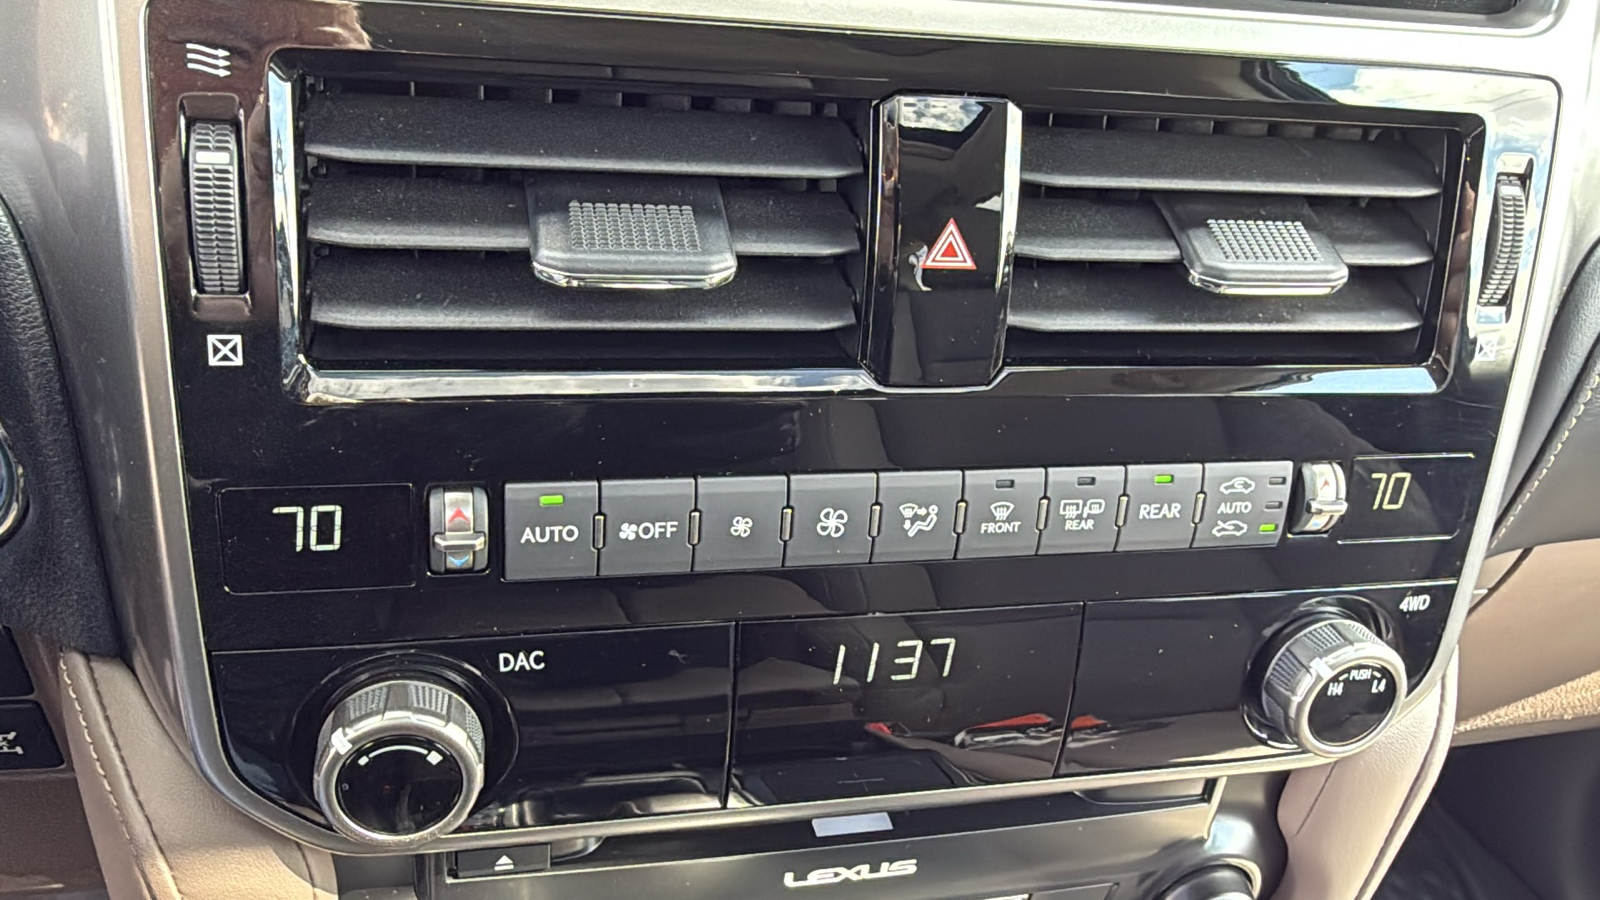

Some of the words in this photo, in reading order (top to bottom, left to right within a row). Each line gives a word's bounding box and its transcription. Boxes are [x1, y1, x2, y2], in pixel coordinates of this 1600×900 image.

[1371, 472, 1411, 511] 70
[1139, 502, 1182, 520] REAR
[1217, 500, 1252, 515] AUTO
[272, 504, 342, 552] 70
[638, 521, 679, 539] OFF
[980, 521, 1021, 536] FRONT
[1064, 518, 1095, 532] REAR
[520, 525, 579, 544] AUTO
[1399, 594, 1431, 612] 4WD
[498, 651, 546, 672] DAC
[1349, 668, 1372, 681] PUSH
[1327, 682, 1344, 696] H4
[1371, 679, 1387, 693] L4
[783, 858, 918, 888] LEXUS
